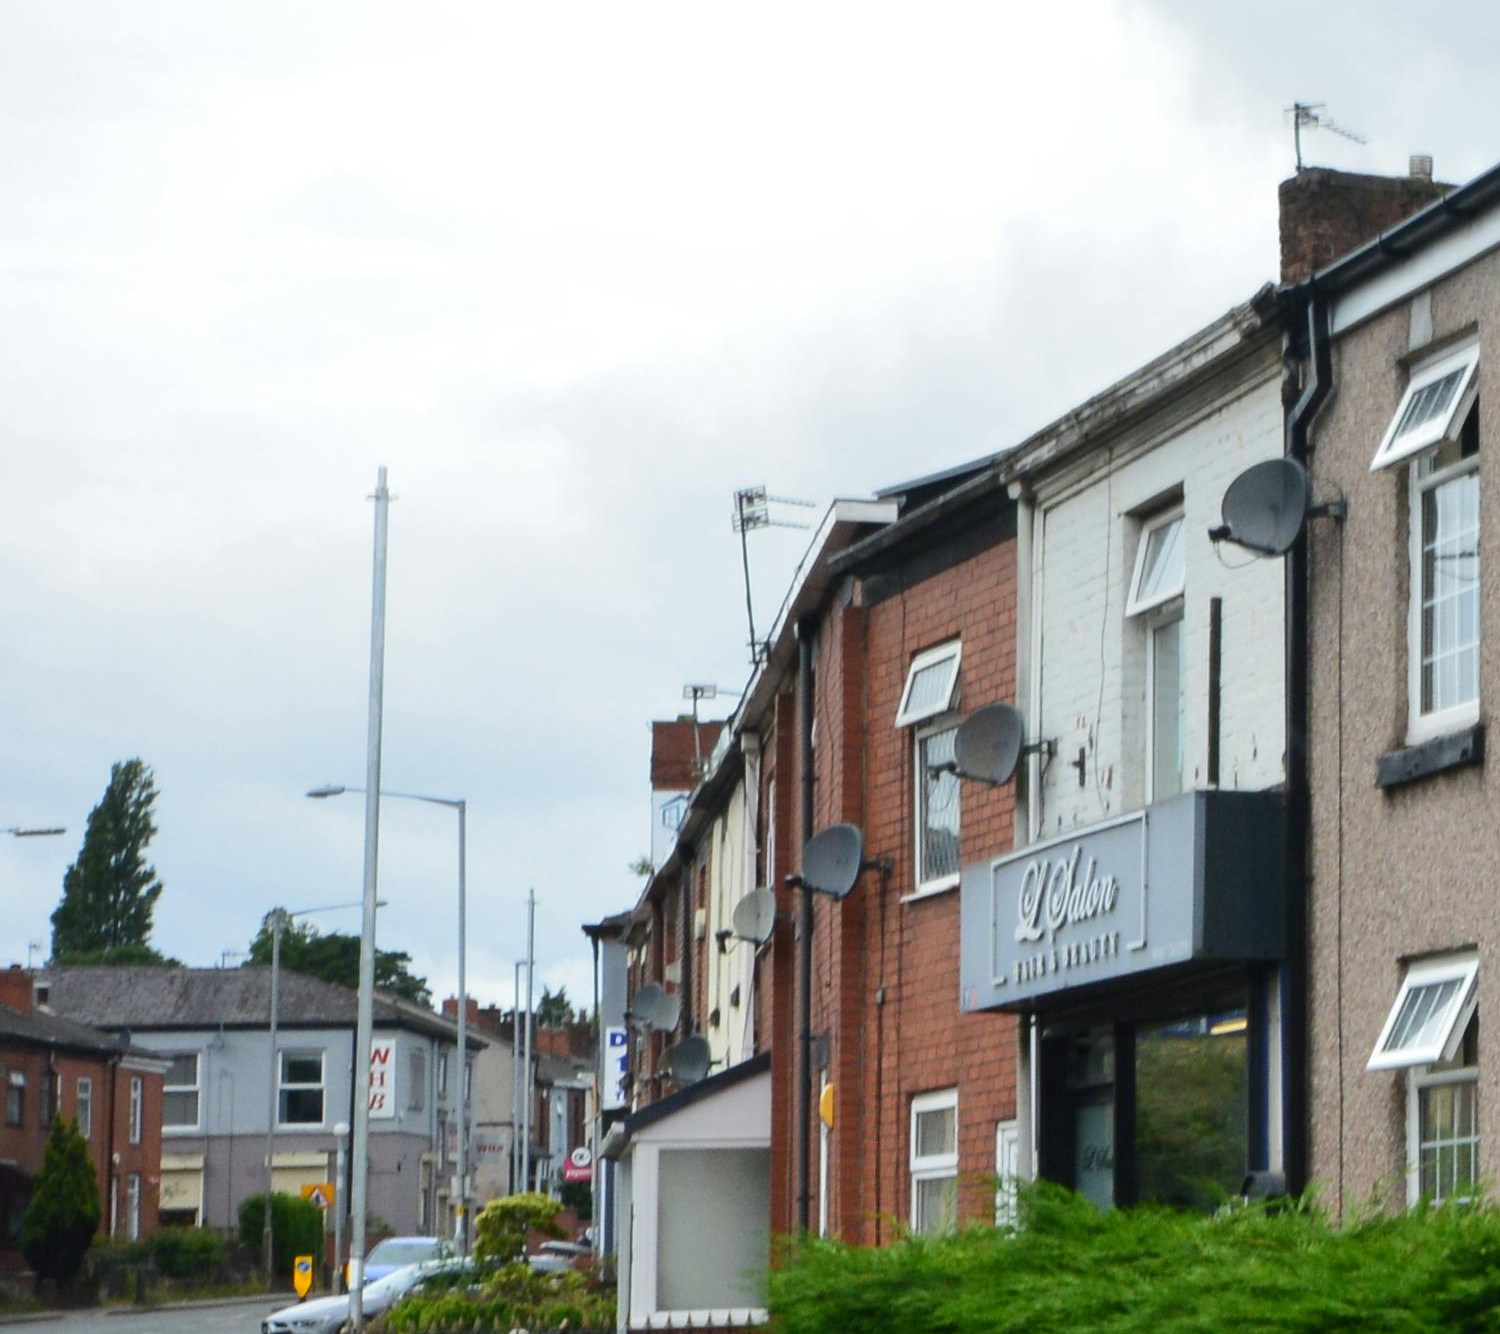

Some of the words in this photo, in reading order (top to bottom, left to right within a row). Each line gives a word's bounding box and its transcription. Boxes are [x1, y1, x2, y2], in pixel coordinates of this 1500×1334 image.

[1046, 843, 1120, 945] Salon
[1014, 953, 1046, 984] HAIR
[1063, 930, 1120, 968] BEAUTY
